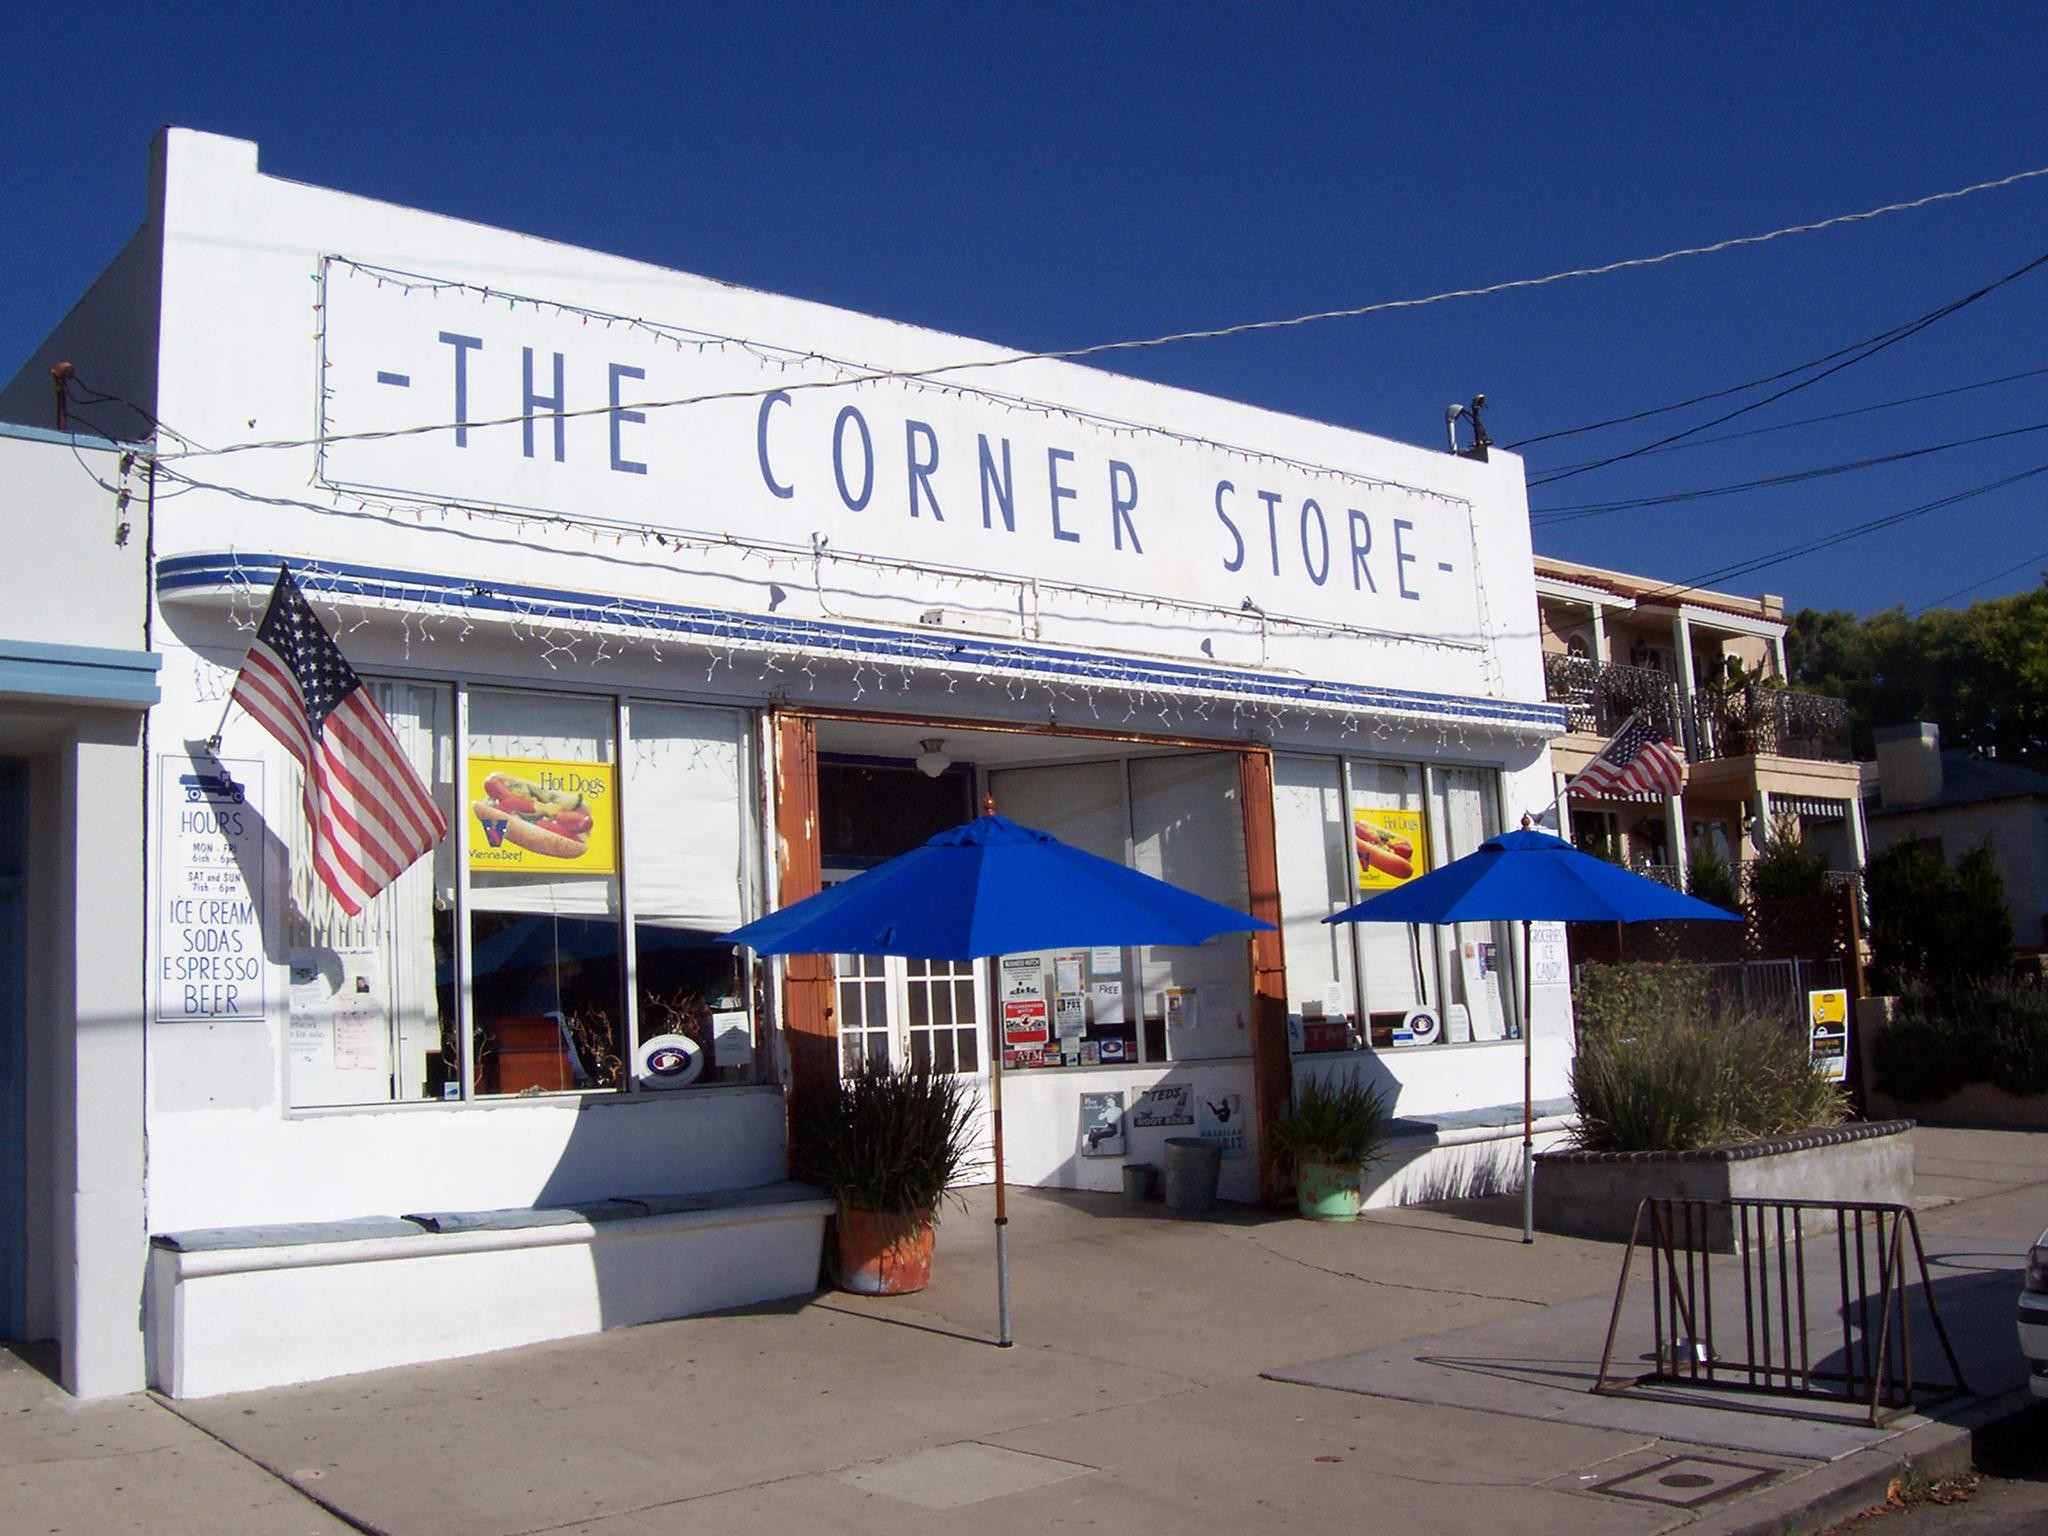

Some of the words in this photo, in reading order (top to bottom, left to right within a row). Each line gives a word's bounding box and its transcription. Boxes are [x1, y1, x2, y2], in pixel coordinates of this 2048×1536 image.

[757, 392, 1144, 555] CORNER
[540, 772, 565, 791] Hot
[569, 773, 606, 798] Dogs
[182, 811, 244, 835] HOURS
[193, 843, 212, 854] MON
[188, 872, 204, 882] SAT
[207, 872, 220, 883] and
[222, 873, 241, 883] SUN
[169, 900, 193, 924] ICE
[199, 900, 254, 925] CREAM
[183, 929, 244, 953] SODAS
[163, 956, 259, 981] ESPRESSO
[185, 984, 239, 1015] BEER
[1099, 985, 1119, 995] FREE
